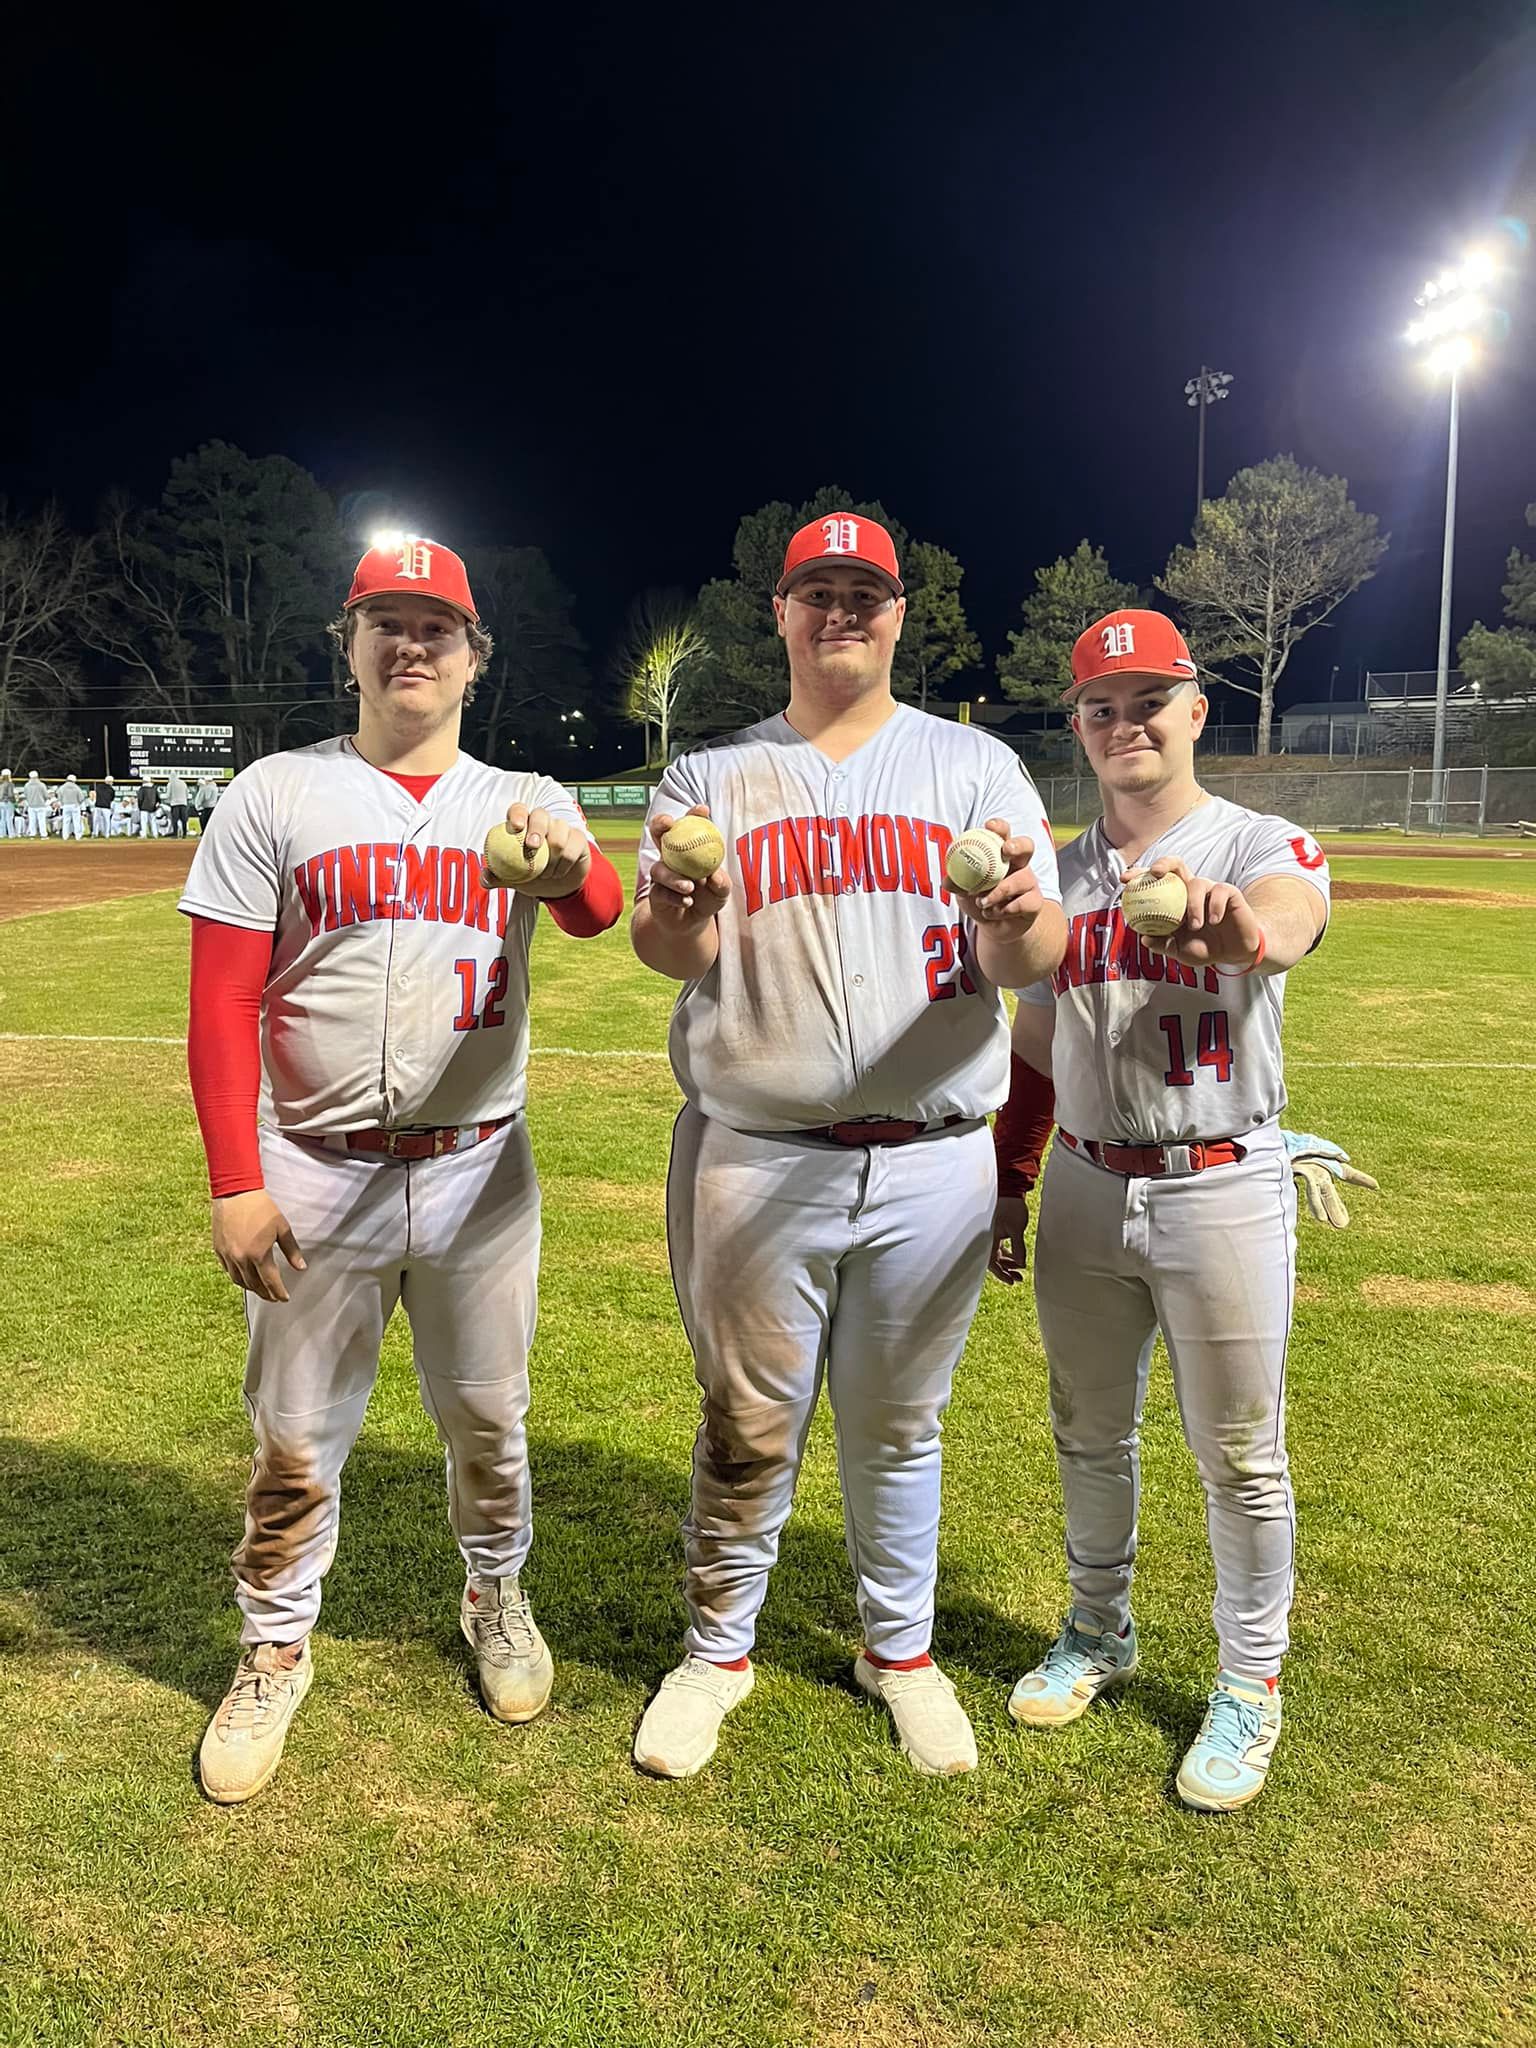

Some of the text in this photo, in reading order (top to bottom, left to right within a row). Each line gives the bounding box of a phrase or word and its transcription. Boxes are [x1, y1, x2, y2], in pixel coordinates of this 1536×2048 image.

[204, 727, 231, 736] FIELD
[453, 955, 509, 1032] 12
[1159, 1010, 1234, 1087] 14
